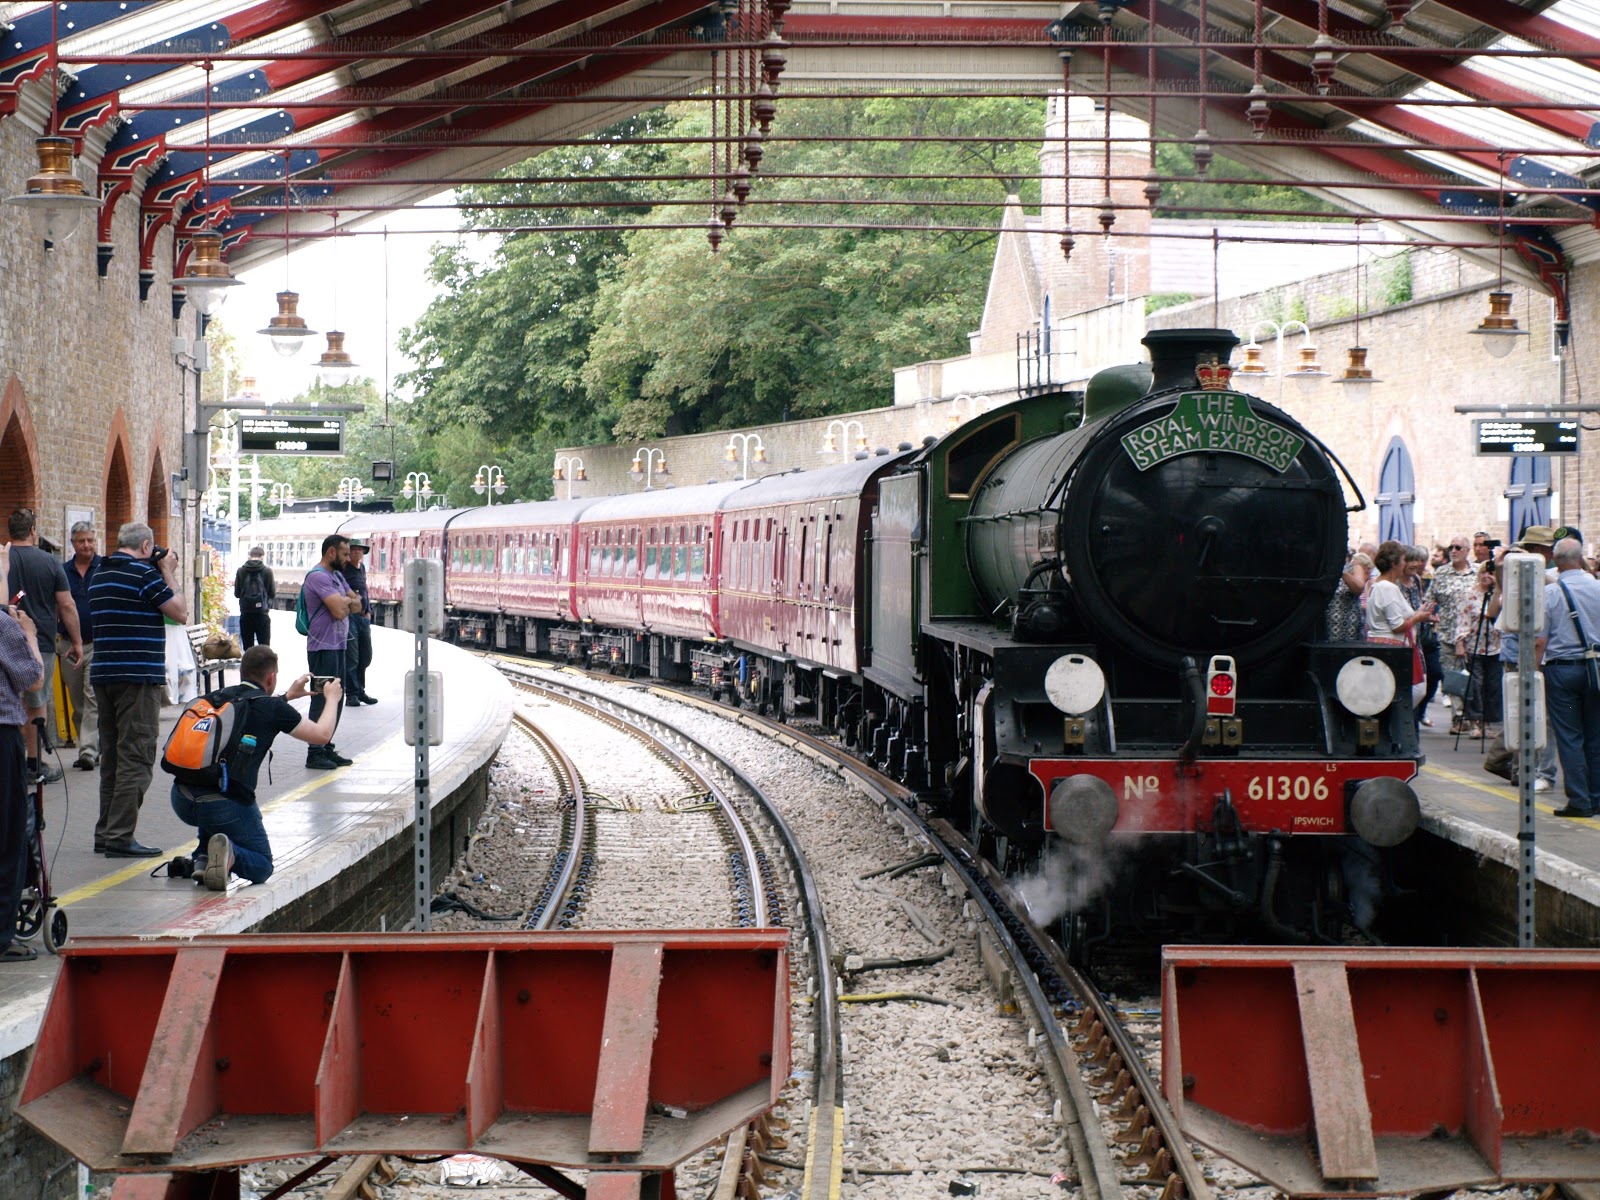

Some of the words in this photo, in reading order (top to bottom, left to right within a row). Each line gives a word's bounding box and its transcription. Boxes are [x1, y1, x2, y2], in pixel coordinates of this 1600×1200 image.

[1191, 395, 1235, 413] THE
[1127, 415, 1192, 450] ROYAL
[1198, 413, 1296, 454] WINDSOR
[1134, 431, 1201, 467] STEAM
[1208, 430, 1291, 469] EXPRESS
[1248, 775, 1329, 801] 61306
[1294, 816, 1334, 827] IPSWICH
